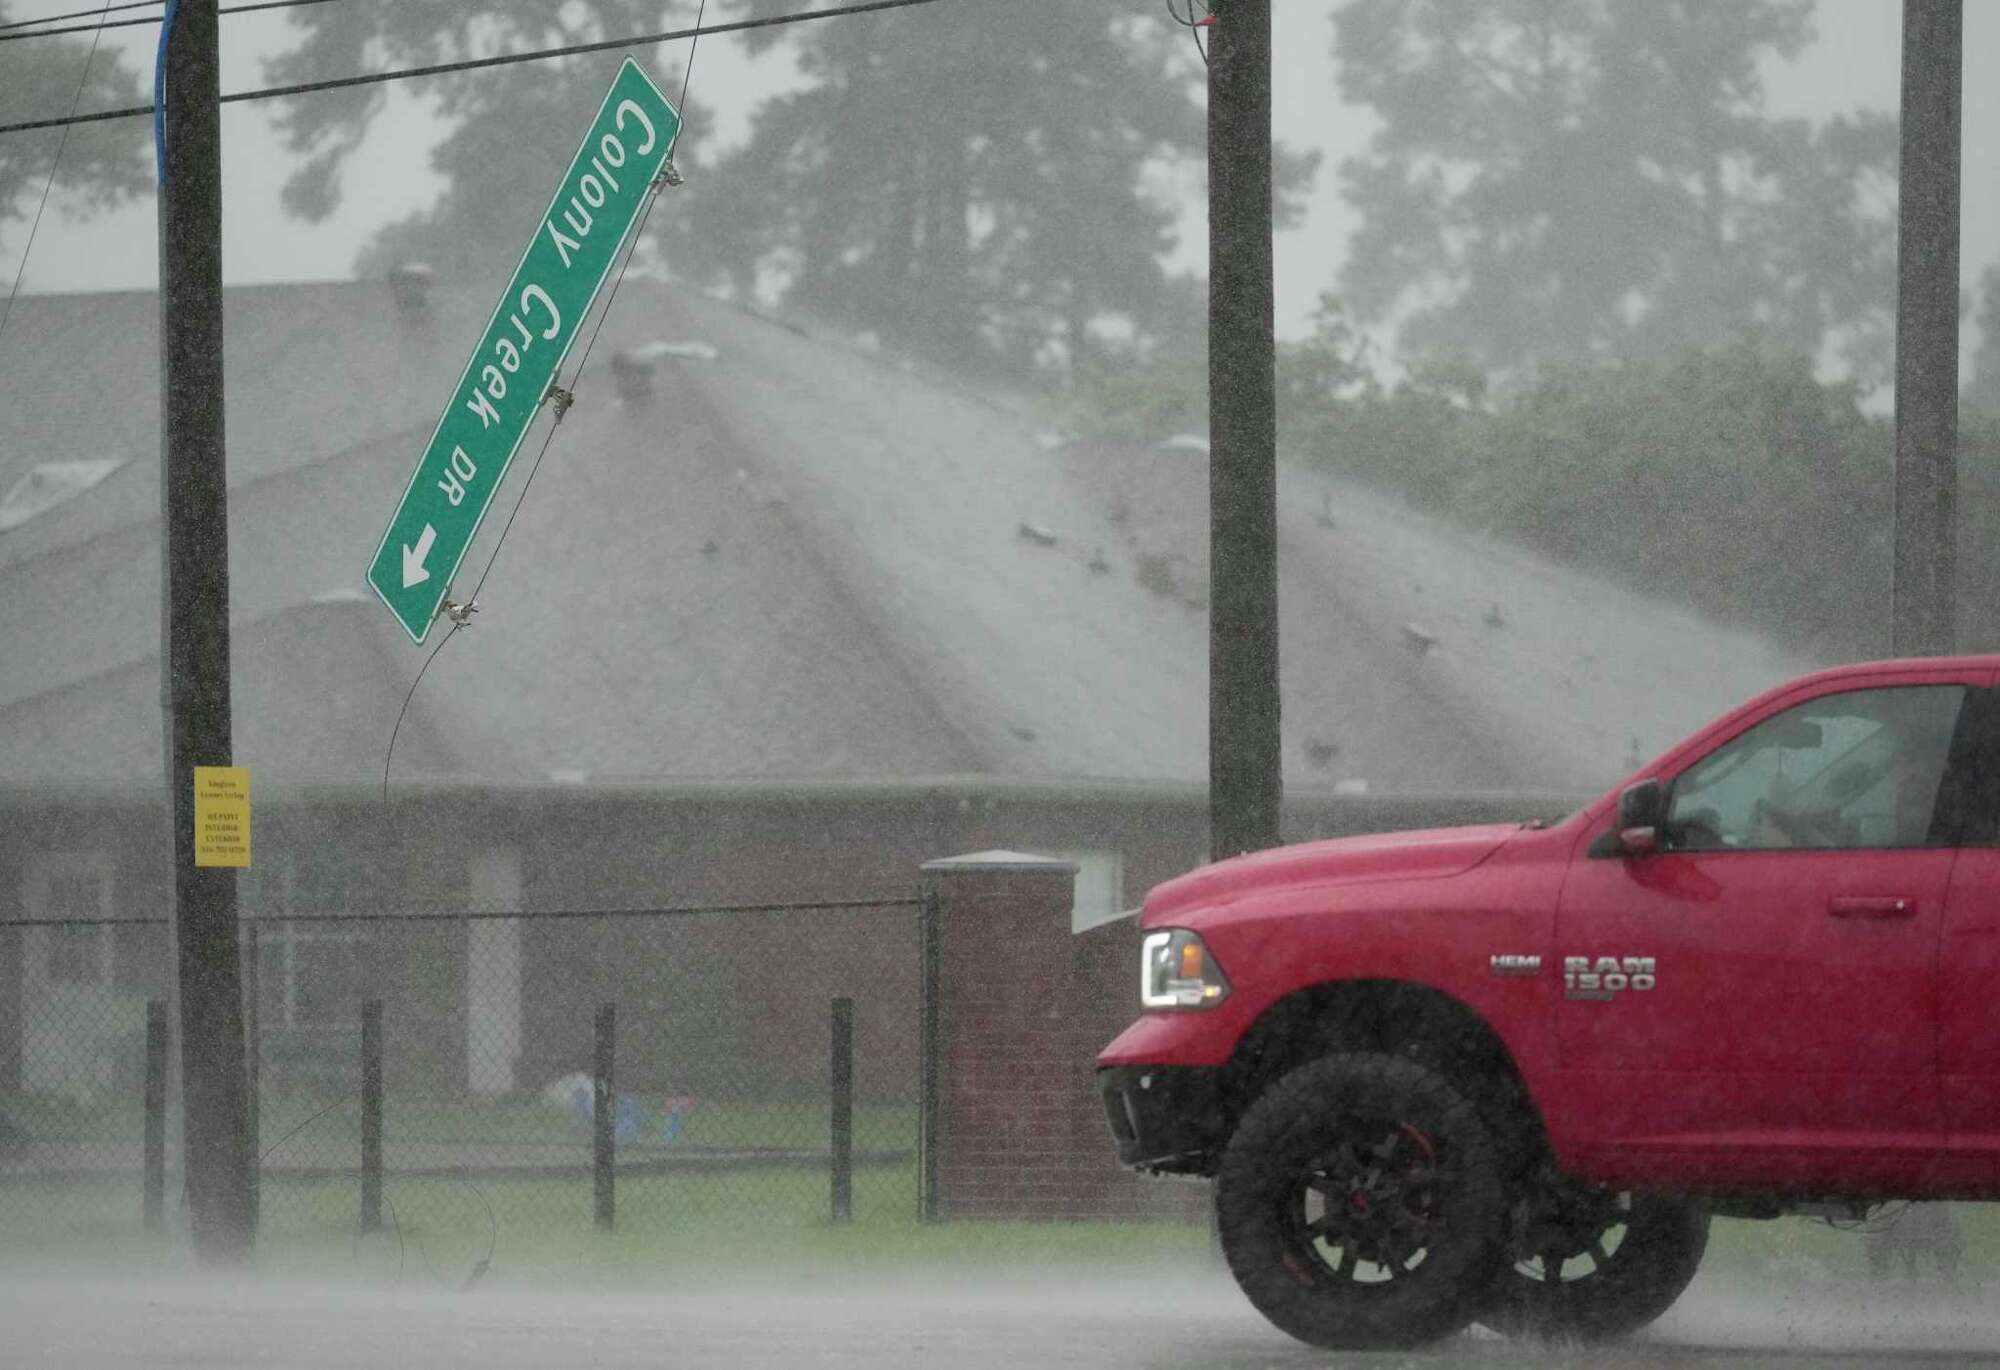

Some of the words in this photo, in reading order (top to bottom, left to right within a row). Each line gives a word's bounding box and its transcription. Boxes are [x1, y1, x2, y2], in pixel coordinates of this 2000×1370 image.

[546, 98, 656, 269] Colony
[465, 283, 562, 430] Creek
[437, 444, 478, 507] DR
[1490, 954, 1542, 968] HEMI
[1565, 956, 1657, 974] RAM
[1564, 973, 1656, 991] 1500
